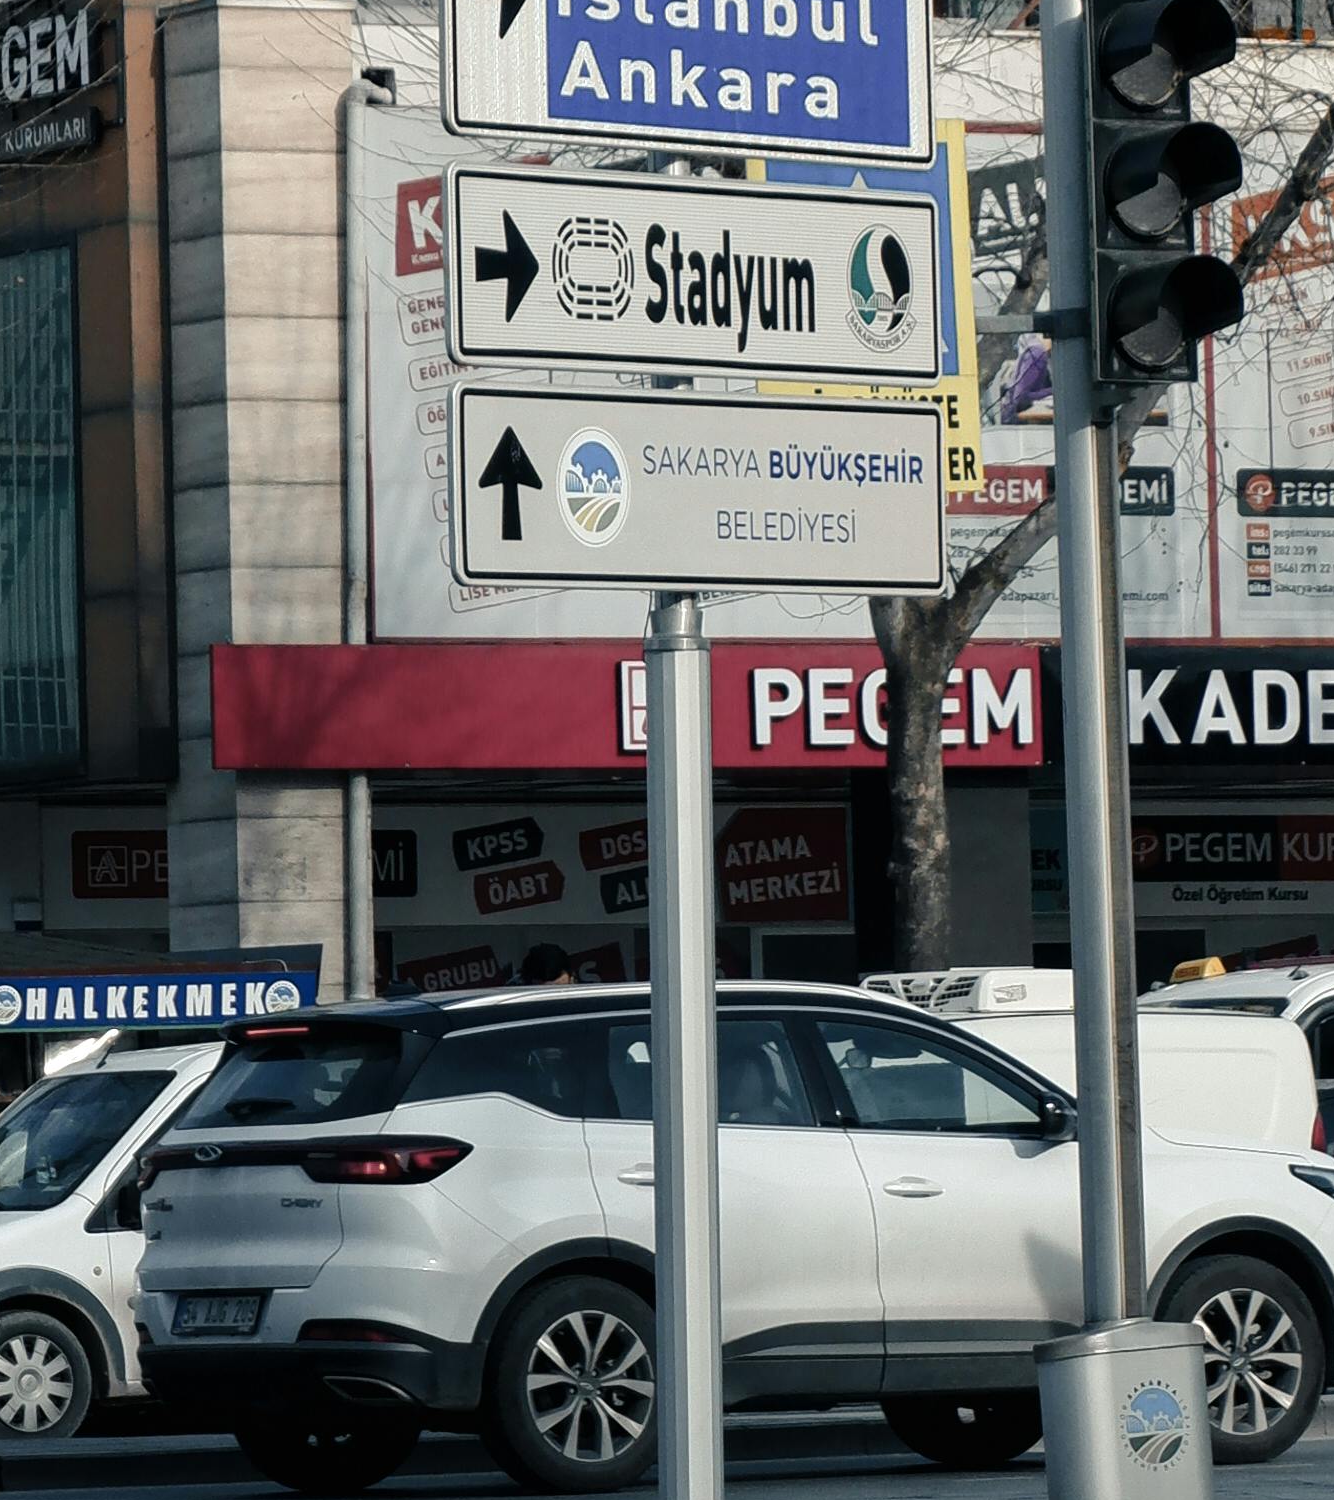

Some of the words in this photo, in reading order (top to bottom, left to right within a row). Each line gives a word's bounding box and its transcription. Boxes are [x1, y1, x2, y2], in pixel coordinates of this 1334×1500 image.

[560, 41, 840, 119] Ankara
[5, 116, 86, 153] KURUMLARI
[644, 223, 817, 352] Stadyum
[408, 296, 444, 315] GENE
[642, 446, 760, 479] SAKARYA
[769, 442, 923, 487] BÜYÜKŞEHİR
[716, 505, 857, 544] BELEDİYESİ
[467, 828, 528, 861] KPSS
[725, 834, 811, 868] ATAMA
[1166, 832, 1272, 863] PEGEM
[489, 872, 549, 905] ÖABT
[729, 861, 842, 904] MERKEZİ
[1173, 887, 1203, 901] Özel
[1207, 884, 1264, 904] Öğretim
[1269, 887, 1308, 901] Kursu
[424, 958, 497, 993] GRUBU
